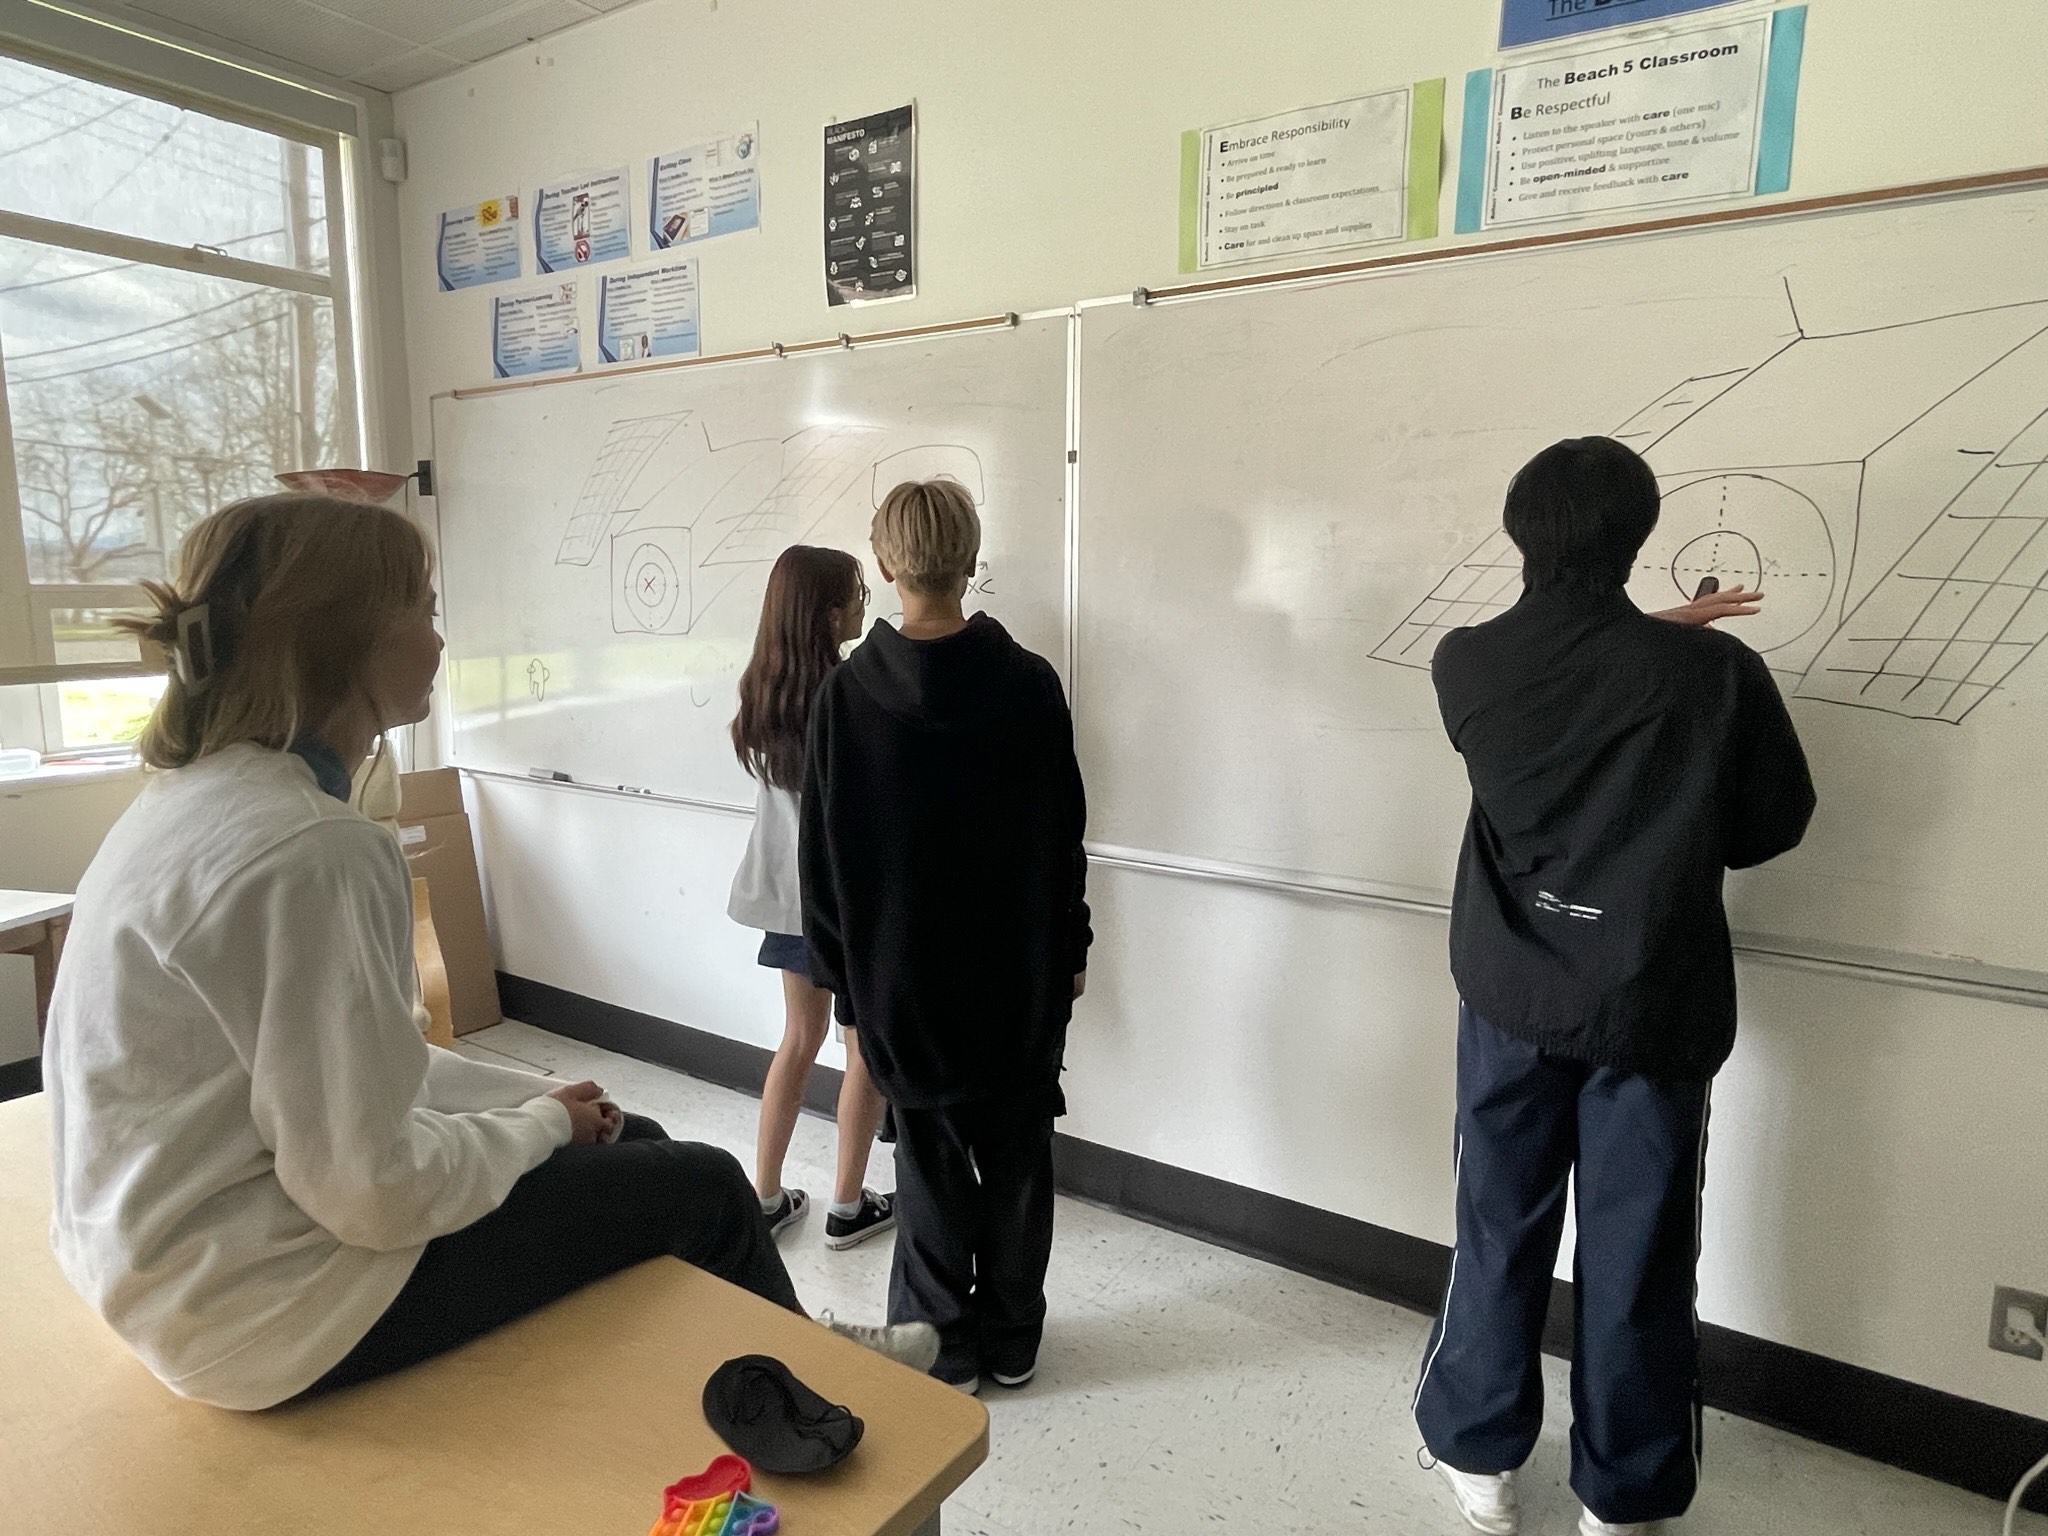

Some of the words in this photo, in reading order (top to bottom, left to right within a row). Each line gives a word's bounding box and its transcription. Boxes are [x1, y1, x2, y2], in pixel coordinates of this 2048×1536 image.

[1537, 76, 1561, 90] The
[1564, 64, 1619, 85] Beach
[1623, 60, 1634, 74] 5
[1639, 44, 1739, 71] Classroom
[1510, 106, 1532, 120] Be
[1535, 91, 1611, 116] Respectful
[827, 128, 866, 145] MANIFESTO
[1220, 135, 1269, 153] Embrace
[1271, 118, 1351, 141] Responsibility
[1522, 143, 1554, 156] Protect
[1555, 136, 1595, 152] personal
[1597, 133, 1624, 146] space
[1625, 128, 1658, 141] (yours
[1659, 125, 1667, 134] &
[1669, 119, 1707, 132] others)
[1523, 129, 1550, 140] Listen
[1552, 127, 1562, 136] to
[1563, 124, 1578, 134] the
[1580, 118, 1616, 132] speaker
[1619, 114, 1641, 124] with
[1643, 109, 1670, 120] care
[1672, 105, 1695, 117] (one
[1227, 158, 1248, 168] Arrive
[1259, 151, 1276, 160] time
[1521, 160, 1536, 170] Use
[1578, 147, 1618, 162] uplifting
[1667, 137, 1689, 148] tone
[1691, 135, 1700, 145] &
[1701, 131, 1740, 143] volume
[1236, 167, 1268, 183] prepared
[1268, 166, 1275, 174] &
[1275, 161, 1296, 173] ready
[1306, 157, 1327, 167] learn
[1520, 177, 1531, 186] Be
[1533, 164, 1606, 184] open-minded
[1608, 162, 1616, 172] &
[1617, 156, 1670, 172] supportive
[1224, 207, 1247, 217] Follow
[1248, 201, 1284, 213] directions
[1284, 198, 1291, 206] &
[1292, 193, 1330, 206] classroom
[1331, 185, 1380, 200] expectations
[1235, 182, 1279, 199] principled
[1519, 191, 1538, 201] Give
[1539, 188, 1556, 199] and
[1558, 183, 1591, 196] receive
[1593, 177, 1635, 191] feedback
[1637, 174, 1659, 184] with
[1661, 171, 1689, 181] care
[1224, 225, 1239, 234] Stay
[1239, 223, 1249, 231] on
[1250, 220, 1266, 229] task
[1224, 240, 1245, 250] Care
[1257, 236, 1271, 245] and
[1271, 232, 1291, 242] clean
[1292, 232, 1302, 241] up
[1303, 228, 1324, 239] space
[1325, 225, 1339, 235] and
[1340, 222, 1373, 234] supplies
